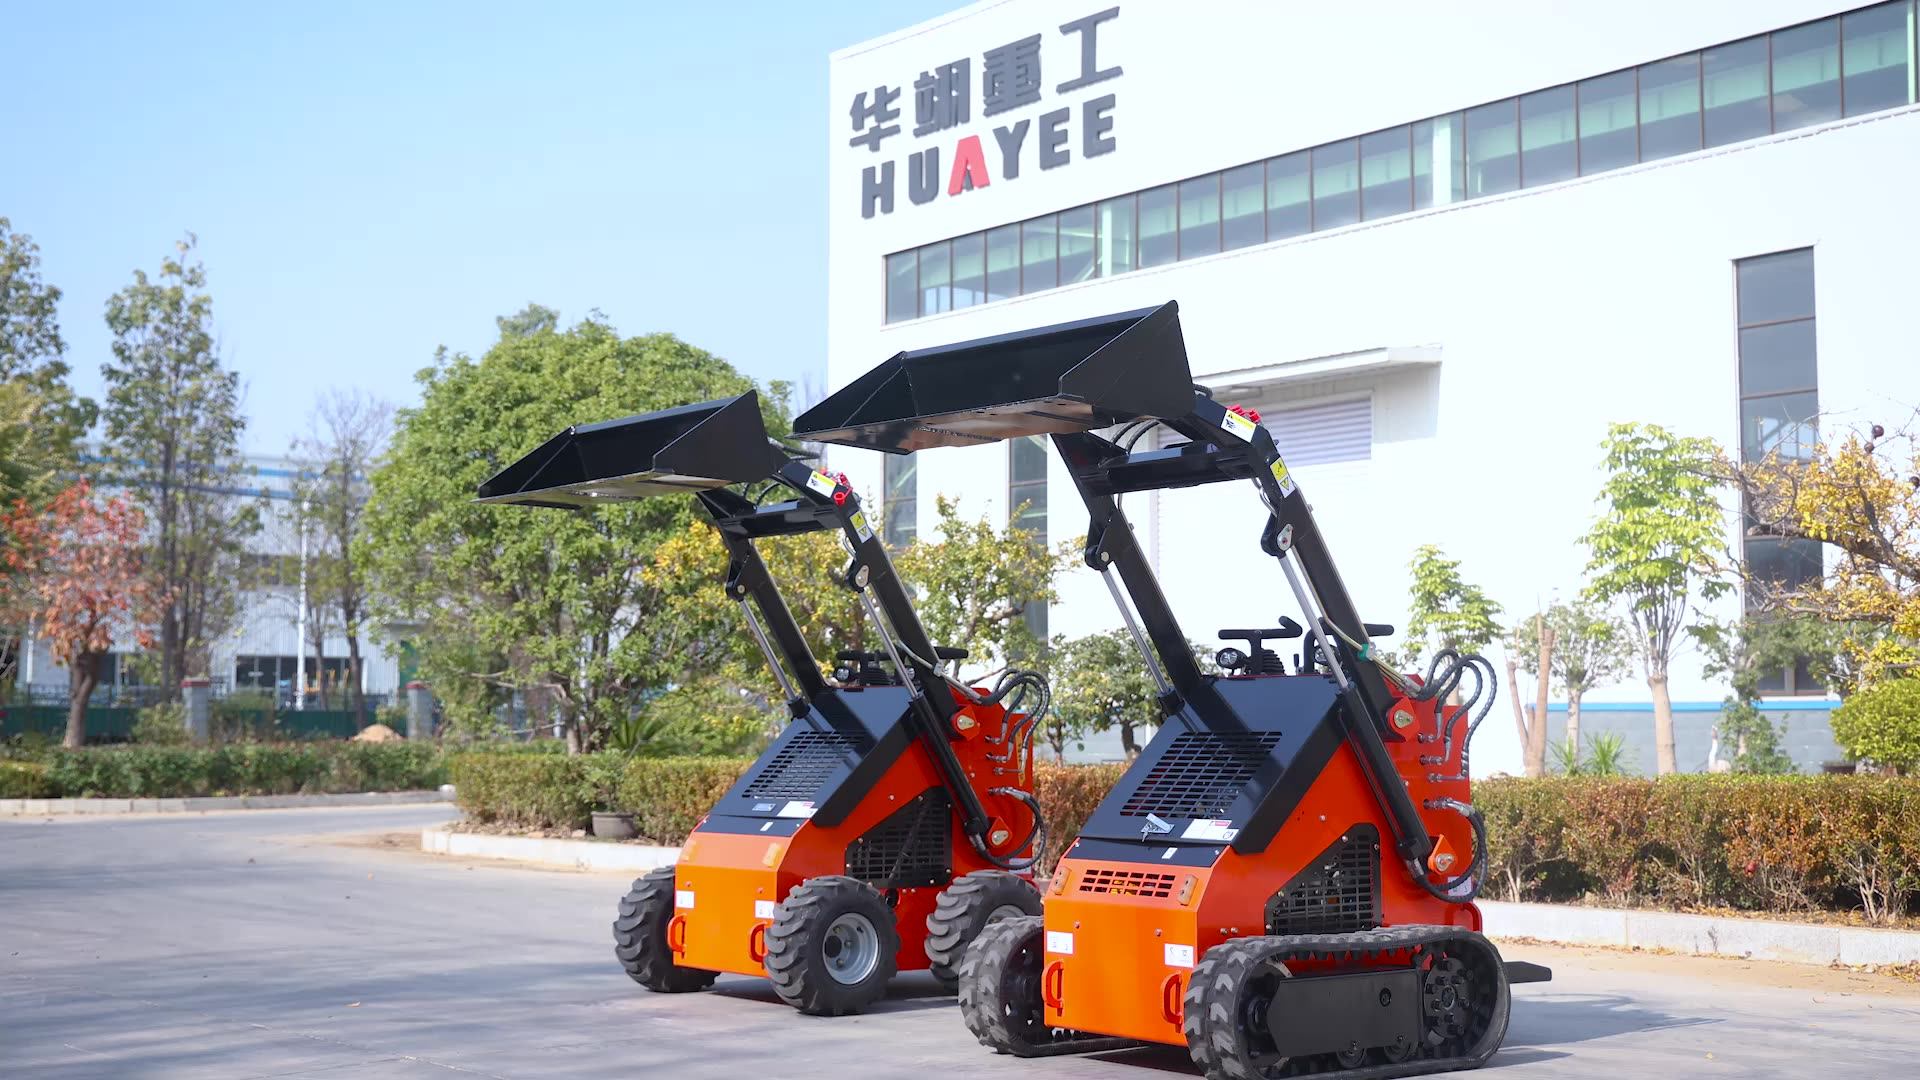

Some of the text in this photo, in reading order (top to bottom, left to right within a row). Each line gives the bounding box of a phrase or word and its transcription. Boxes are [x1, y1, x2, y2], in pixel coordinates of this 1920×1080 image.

[849, 6, 1123, 153] 华翊重工
[861, 94, 1117, 219] HUAYEE
